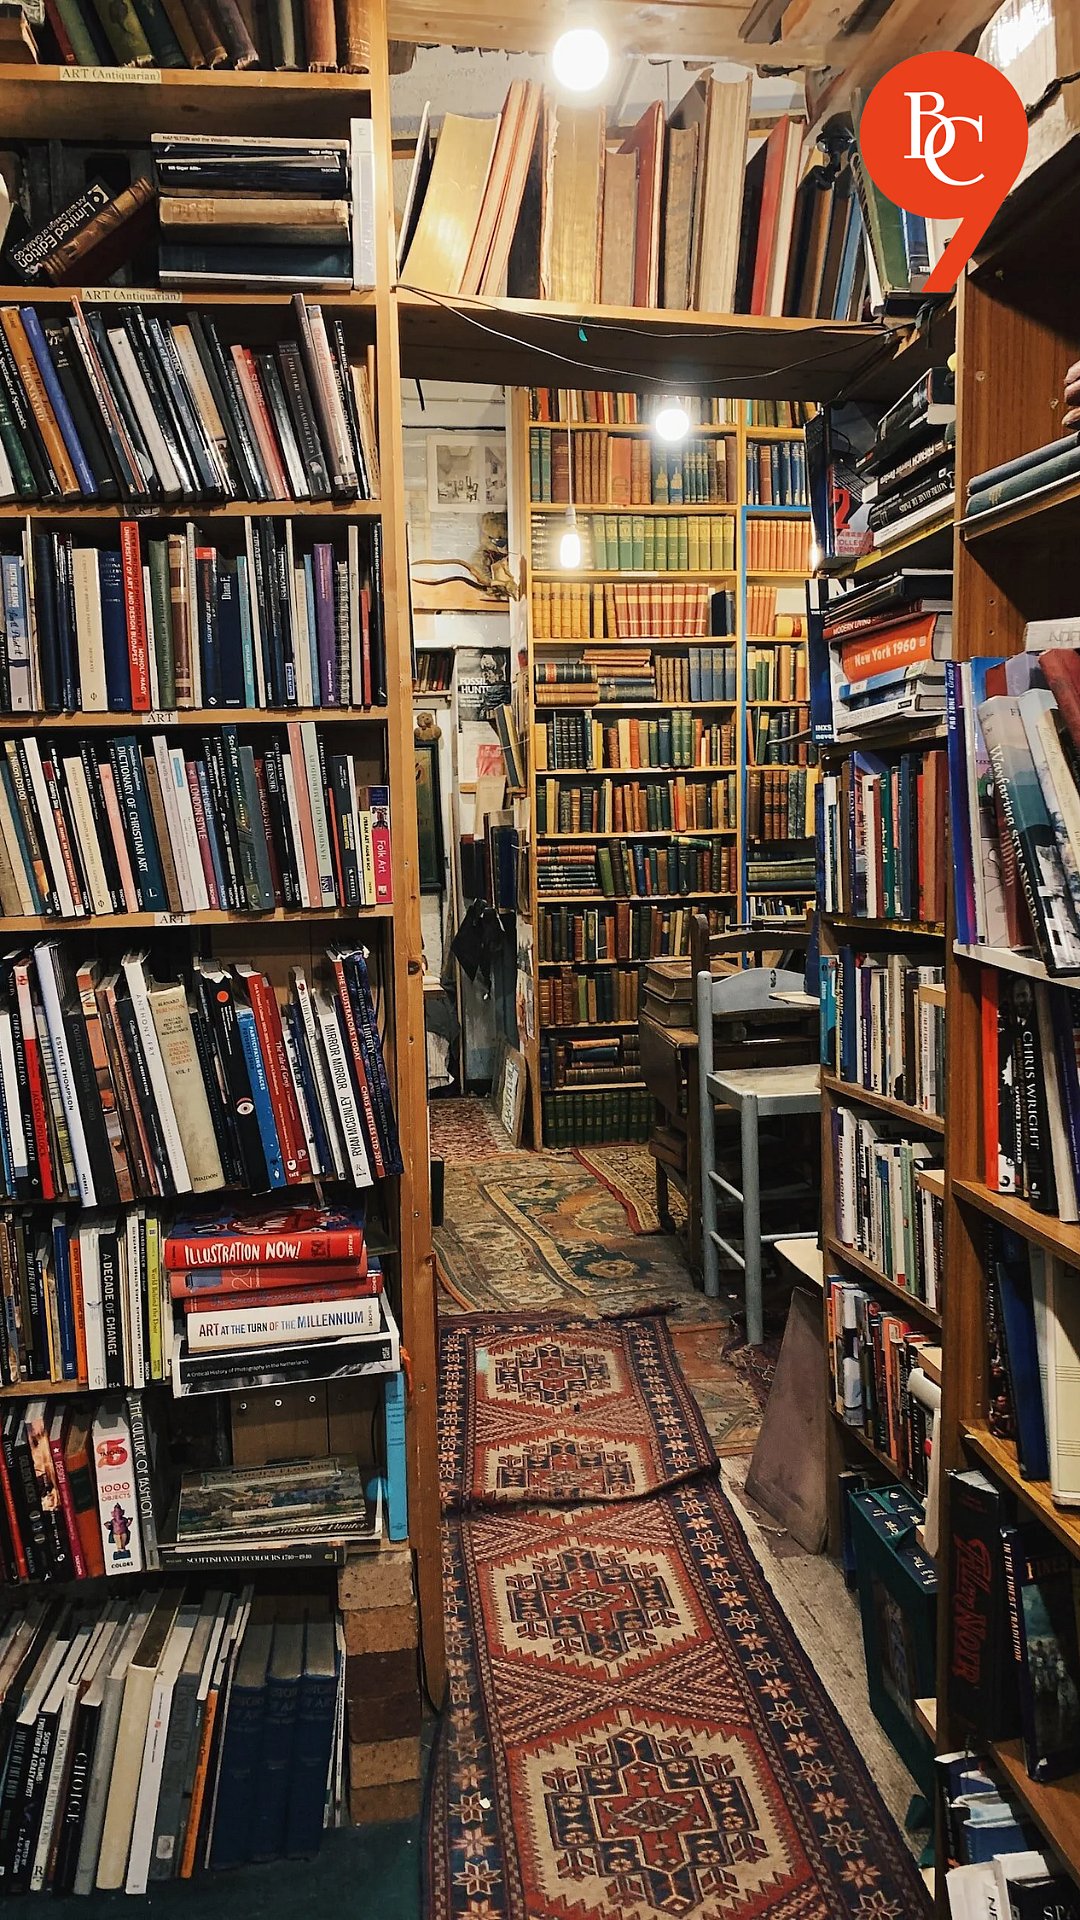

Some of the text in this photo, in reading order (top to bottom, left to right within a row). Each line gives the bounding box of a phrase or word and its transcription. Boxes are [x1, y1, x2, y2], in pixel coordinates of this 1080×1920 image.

[61, 67, 161, 82] ART (Antiquarian)
[65, 204, 77, 216] and
[74, 194, 87, 207] Art
[40, 228, 49, 237] of
[45, 210, 68, 232] Design
[16, 199, 96, 272] Limited Edition
[84, 289, 182, 302] ART (Antiquarian)
[150, 323, 164, 346] Dance
[336, 327, 348, 369] ANDY WARHOL
[158, 347, 167, 356] of
[161, 356, 177, 386] Rapture
[0, 355, 28, 430] Spectacle of Spectacles
[287, 357, 295, 372] THE
[299, 410, 310, 436] AMBER
[122, 526, 131, 565] UNIVERSITY
[125, 566, 132, 574] OF
[129, 631, 138, 665] BUDAPEST
[854, 637, 916, 668] New York 1960
[137, 648, 146, 695] MOHOLY-NAGY
[460, 677, 488, 685] FOSSIL
[947, 672, 955, 689] Grade
[148, 713, 173, 723] ART
[815, 724, 832, 732] INXS
[949, 715, 957, 730] PRO
[9, 755, 26, 800] Nikon D3100
[84, 765, 93, 789] ROTHKO
[216, 742, 227, 786] FRANCIS BACON
[266, 762, 276, 790] RENOIR
[116, 745, 148, 873] DICTIONARY OF CHRISTIAN ART
[189, 783, 206, 839] LONDON STYLE
[375, 839, 387, 873] Folk Art
[348, 874, 356, 898] PRESTEL
[160, 915, 185, 925] ART
[9, 1013, 21, 1038] CHRIS
[135, 993, 150, 1038] ANTHONY
[145, 1041, 155, 1057] FRY
[336, 970, 361, 1061] THE ILLUSTRATORS TODAY
[246, 1026, 266, 1090] PARTICIPATING SPACES
[275, 1041, 283, 1052] The
[277, 1051, 285, 1064] Tale
[323, 1023, 347, 1090] MIRROR MIRROR
[54, 1036, 74, 1111] ESTELLE THOMPSON
[280, 1071, 291, 1088] Genji
[1021, 1030, 1041, 1151] CHRIS WRIGHT
[30, 1090, 48, 1158] JACKSON POLLOCK
[340, 1095, 362, 1157] RYAN MCGINLEY
[360, 1085, 382, 1167] CHRIS BEETLES LTD 2017
[193, 1172, 219, 1183] PHAIDON
[184, 1240, 302, 1266] ILLUSTRATION NOW!
[29, 1282, 35, 1291] OF
[103, 1262, 114, 1300] DECADE
[105, 1302, 114, 1313] OF
[150, 1286, 158, 1306] Behind
[106, 1316, 117, 1356] CHANGE
[199, 1310, 364, 1337] ART AT THE TURN OF THE MILLENNIUM
[210, 1368, 228, 1376] History
[235, 1364, 265, 1374] Photography
[280, 1359, 309, 1367] Netherlands
[55, 1460, 65, 1483] DESIGN
[128, 1401, 153, 1519] THE CULTURE OF FASHION
[101, 1482, 130, 1494] 1000
[101, 1492, 132, 1502] OBJECTS
[111, 1561, 134, 1569] COLORS
[1002, 1542, 1021, 1662] IN THE FINEST TRADITION
[948, 1608, 989, 1683] NOIR
[34, 1731, 51, 1785] SOPHIE CRUMB:
[65, 1751, 88, 1824] CHOICE
